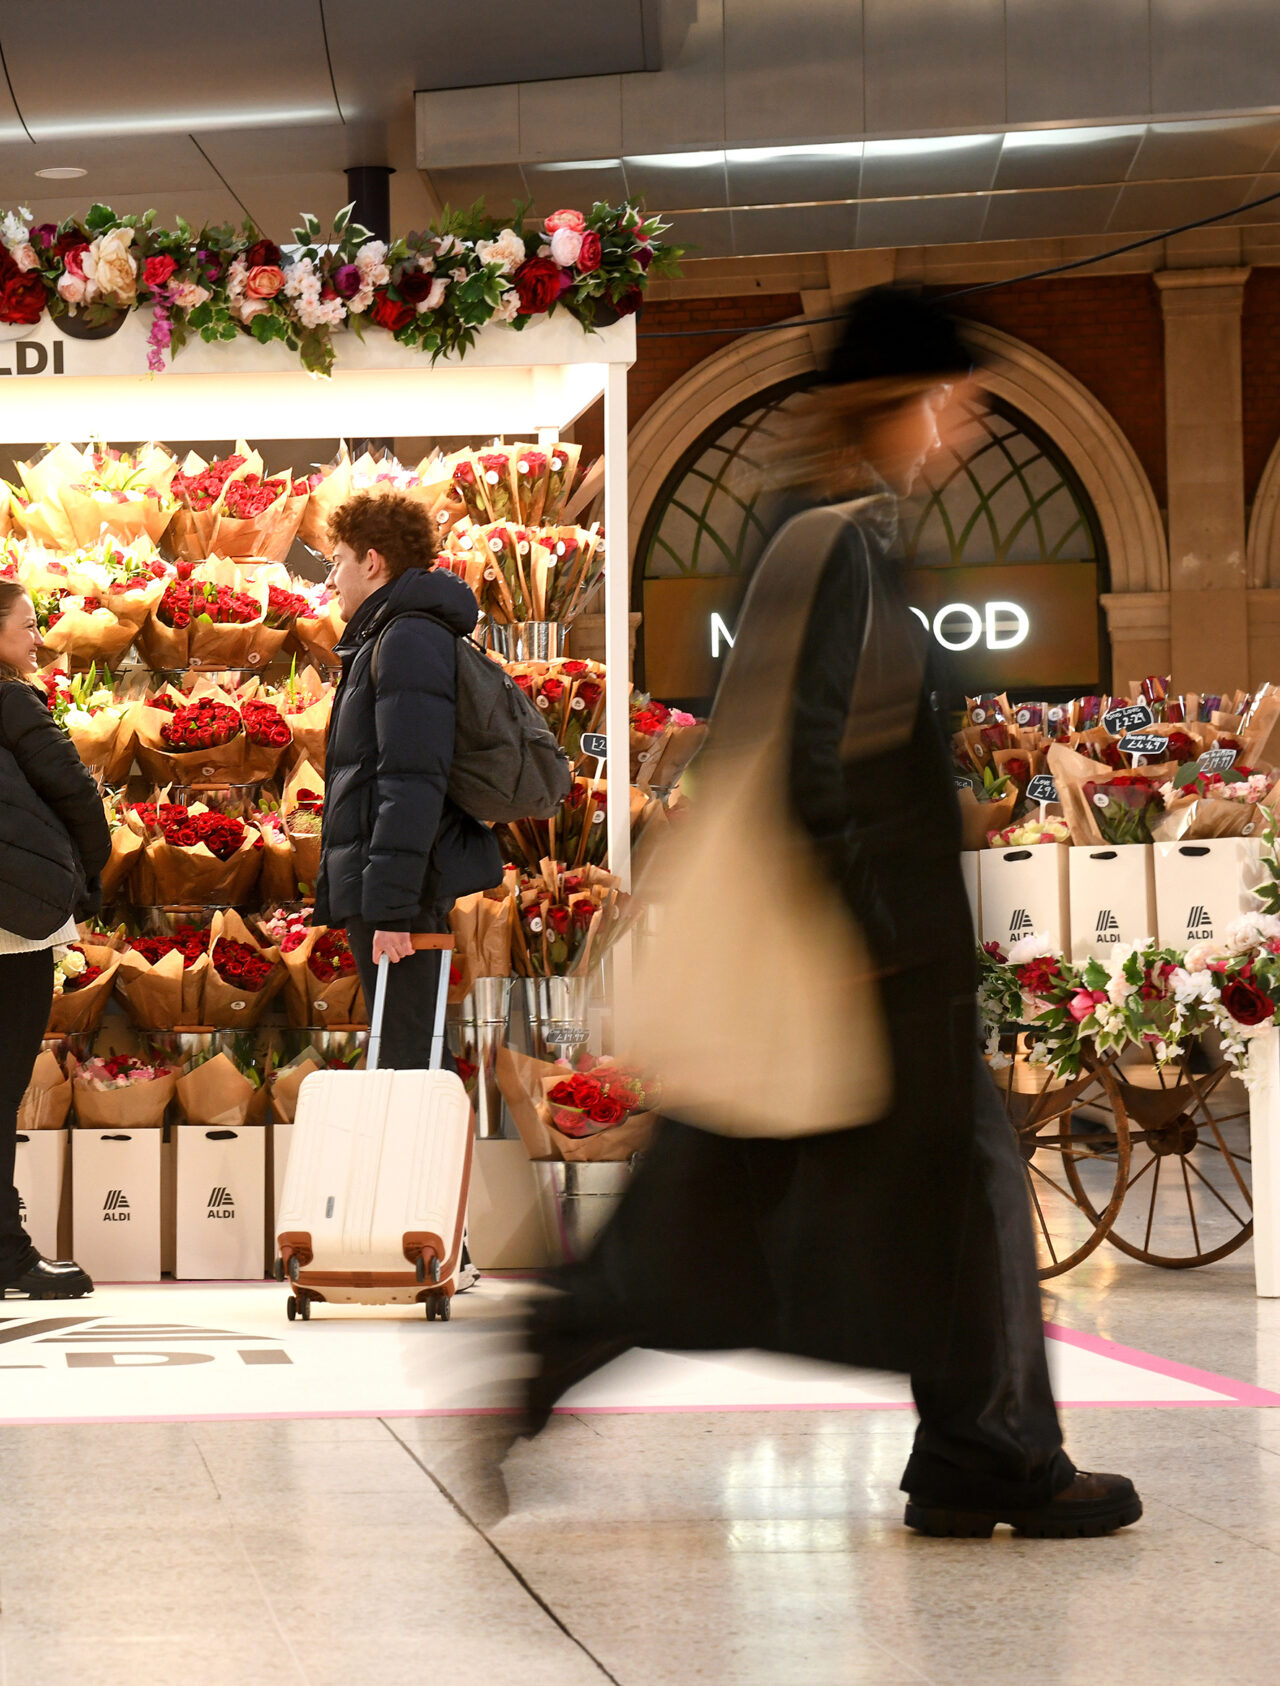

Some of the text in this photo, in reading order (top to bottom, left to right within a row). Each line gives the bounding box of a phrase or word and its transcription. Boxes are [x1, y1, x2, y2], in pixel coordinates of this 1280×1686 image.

[1096, 934, 1121, 944] ALDI
[1187, 930, 1214, 940] ALDI
[103, 1213, 130, 1221] ALDI
[207, 1211, 235, 1219] ALDI
